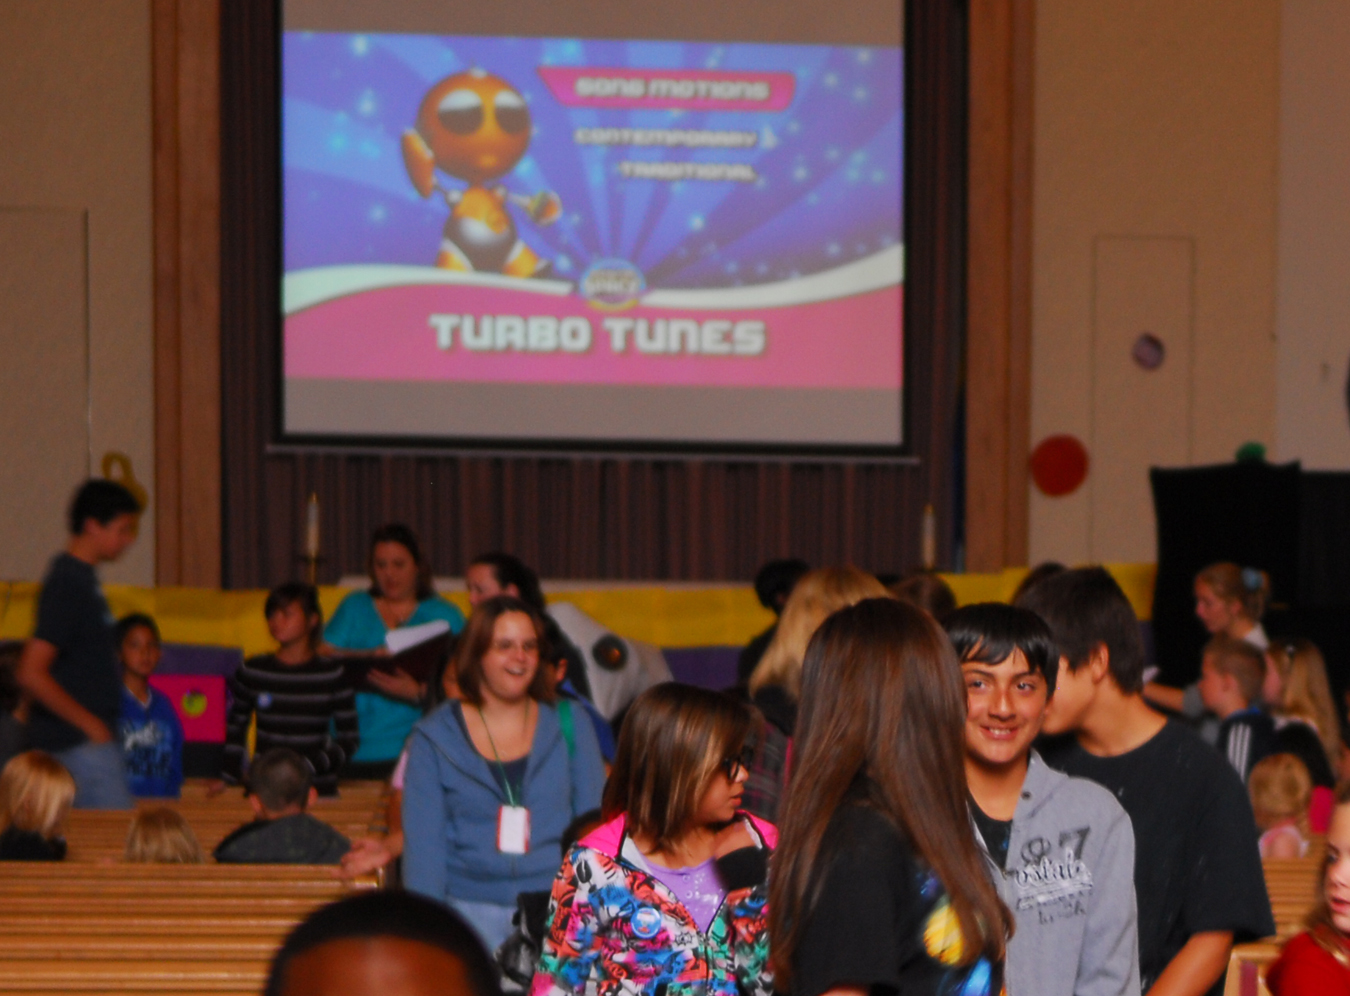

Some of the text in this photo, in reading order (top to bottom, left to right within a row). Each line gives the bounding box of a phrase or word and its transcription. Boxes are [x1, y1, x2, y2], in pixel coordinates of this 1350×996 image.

[650, 79, 770, 101] MOTIONS
[574, 127, 758, 148] CONTEMPORARY
[619, 160, 757, 183] TRADITIONAL
[429, 313, 767, 356] TURBO TUNES
